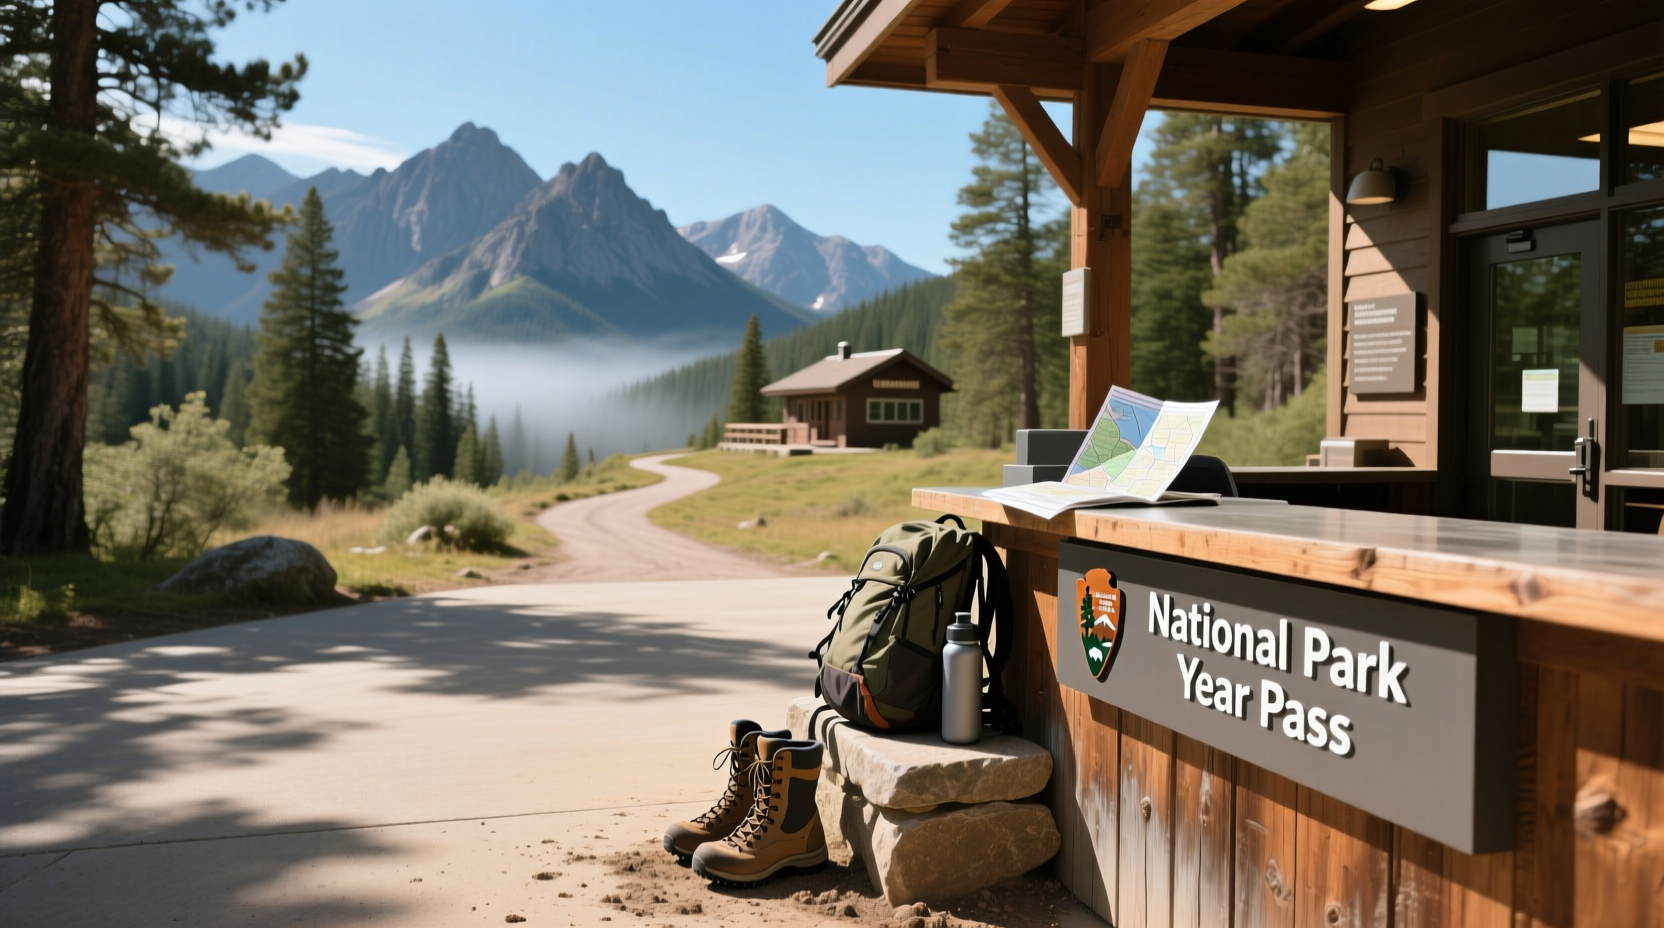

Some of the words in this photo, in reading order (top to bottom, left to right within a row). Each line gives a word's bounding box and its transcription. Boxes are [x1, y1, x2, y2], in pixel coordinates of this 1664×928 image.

[1149, 591, 1288, 671] National
[1304, 626, 1407, 704] Park
[1177, 653, 1250, 718] Year
[1260, 679, 1351, 756] Pass
